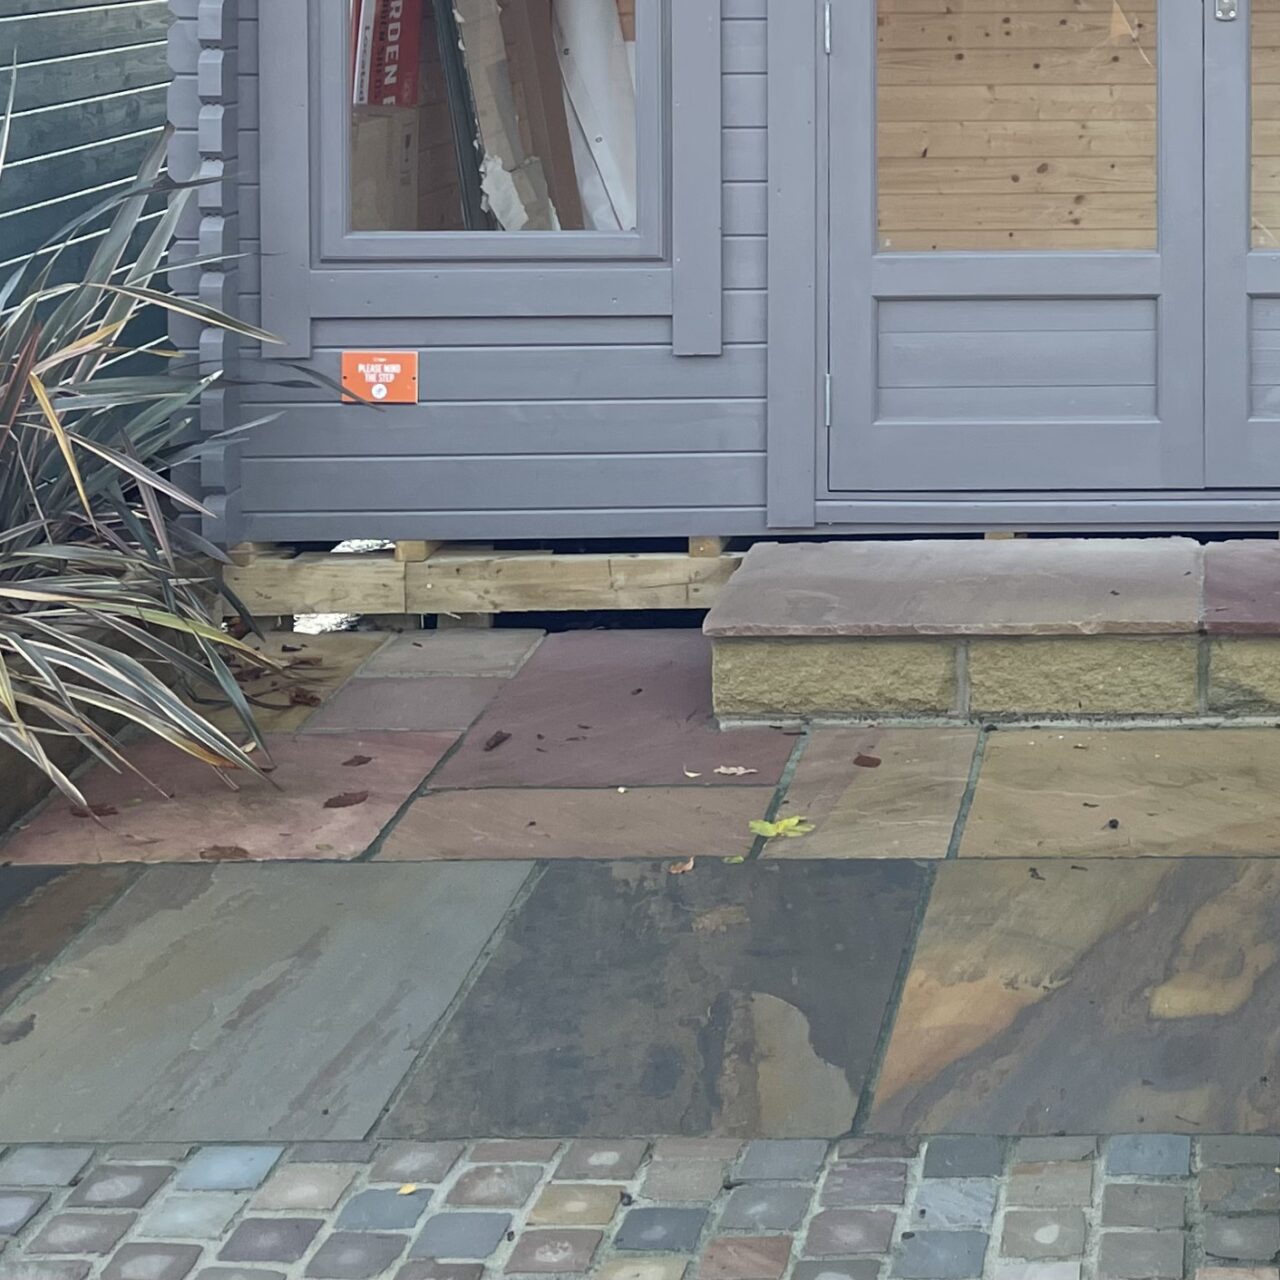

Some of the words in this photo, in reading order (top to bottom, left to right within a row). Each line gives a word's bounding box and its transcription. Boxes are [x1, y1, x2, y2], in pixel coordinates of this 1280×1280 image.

[357, 363, 382, 374] PLEASE
[383, 363, 401, 374] MIND
[364, 373, 378, 383] THE
[378, 373, 395, 383] STEP
